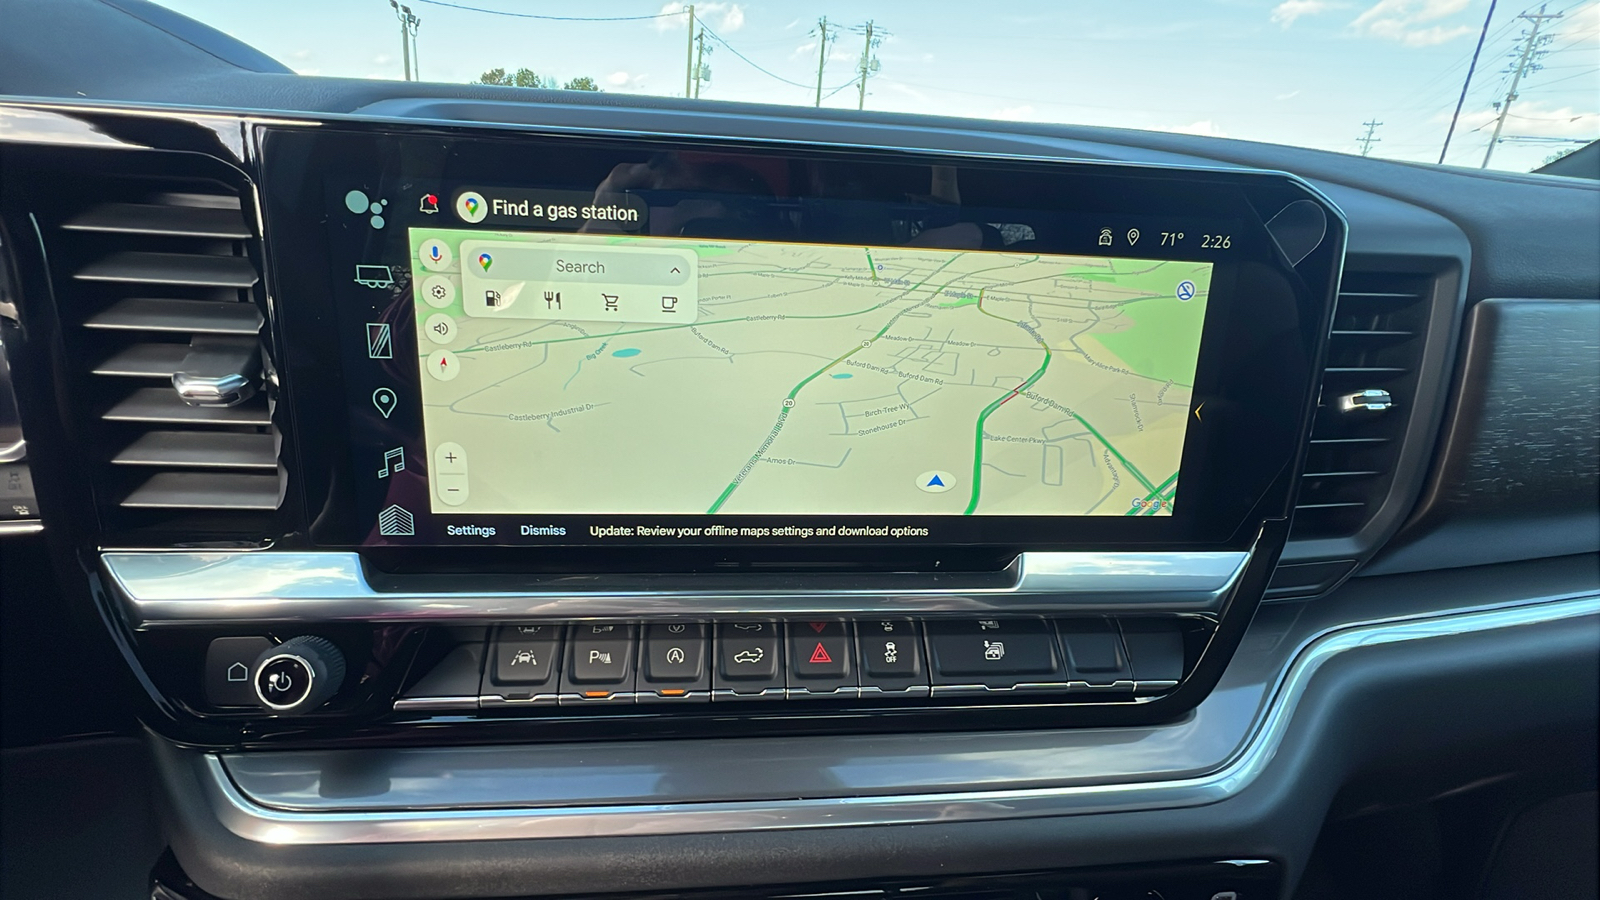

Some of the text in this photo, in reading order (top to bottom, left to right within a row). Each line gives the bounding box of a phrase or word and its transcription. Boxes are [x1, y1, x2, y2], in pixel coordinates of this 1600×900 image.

[492, 199, 638, 221] Find a gas station
[1201, 234, 1231, 249] 2:26
[556, 259, 605, 274] Search
[484, 343, 522, 352] Castleberry
[691, 327, 729, 355] Buford Dam Rd
[586, 353, 597, 361] Big
[846, 360, 888, 375] Buford Dam Rd
[1108, 365, 1121, 373] Park
[898, 371, 943, 386] Buford Dam Rd
[899, 403, 910, 412] Wy
[1026, 391, 1075, 417] Buford Dam Rd
[508, 403, 595, 422] Castleberry Industrial Dr
[858, 422, 898, 437] Stonehouse
[1006, 435, 1028, 443] Center
[1029, 437, 1046, 446] Pkwy
[733, 412, 788, 485] Veterans Memorial Blvd
[766, 457, 796, 466] Amos Dr
[447, 524, 496, 539] Settings
[520, 524, 567, 536] Dismiss
[589, 525, 929, 539] Update: Review your offline maps settings and download options
